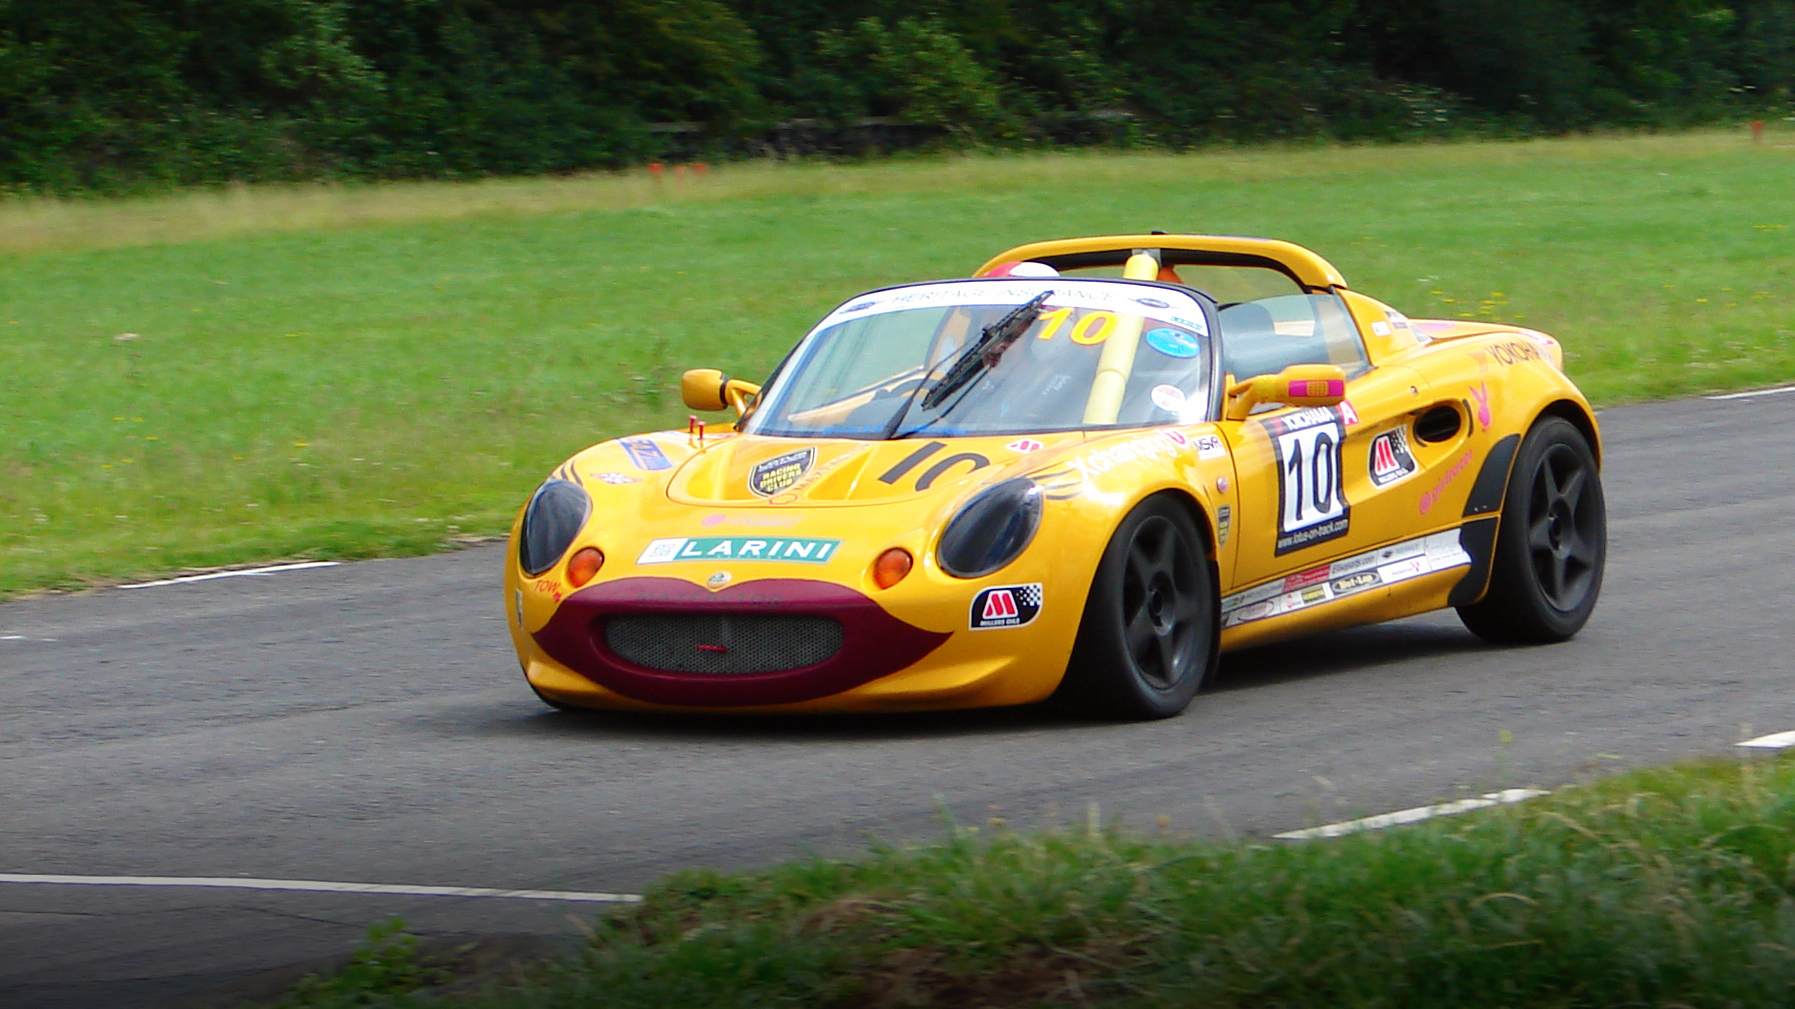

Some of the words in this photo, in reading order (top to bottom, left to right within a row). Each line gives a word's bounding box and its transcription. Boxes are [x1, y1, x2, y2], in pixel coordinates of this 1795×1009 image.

[1037, 306, 1119, 345] 10
[1281, 406, 1335, 430] YOKOHAMA
[1339, 401, 1358, 425] A
[759, 470, 802, 488] DRIVERS
[763, 463, 801, 480] RACING
[1288, 431, 1333, 521] 10
[767, 478, 793, 492] CLUB
[681, 540, 832, 559] LARINI
[534, 580, 561, 593] TOW
